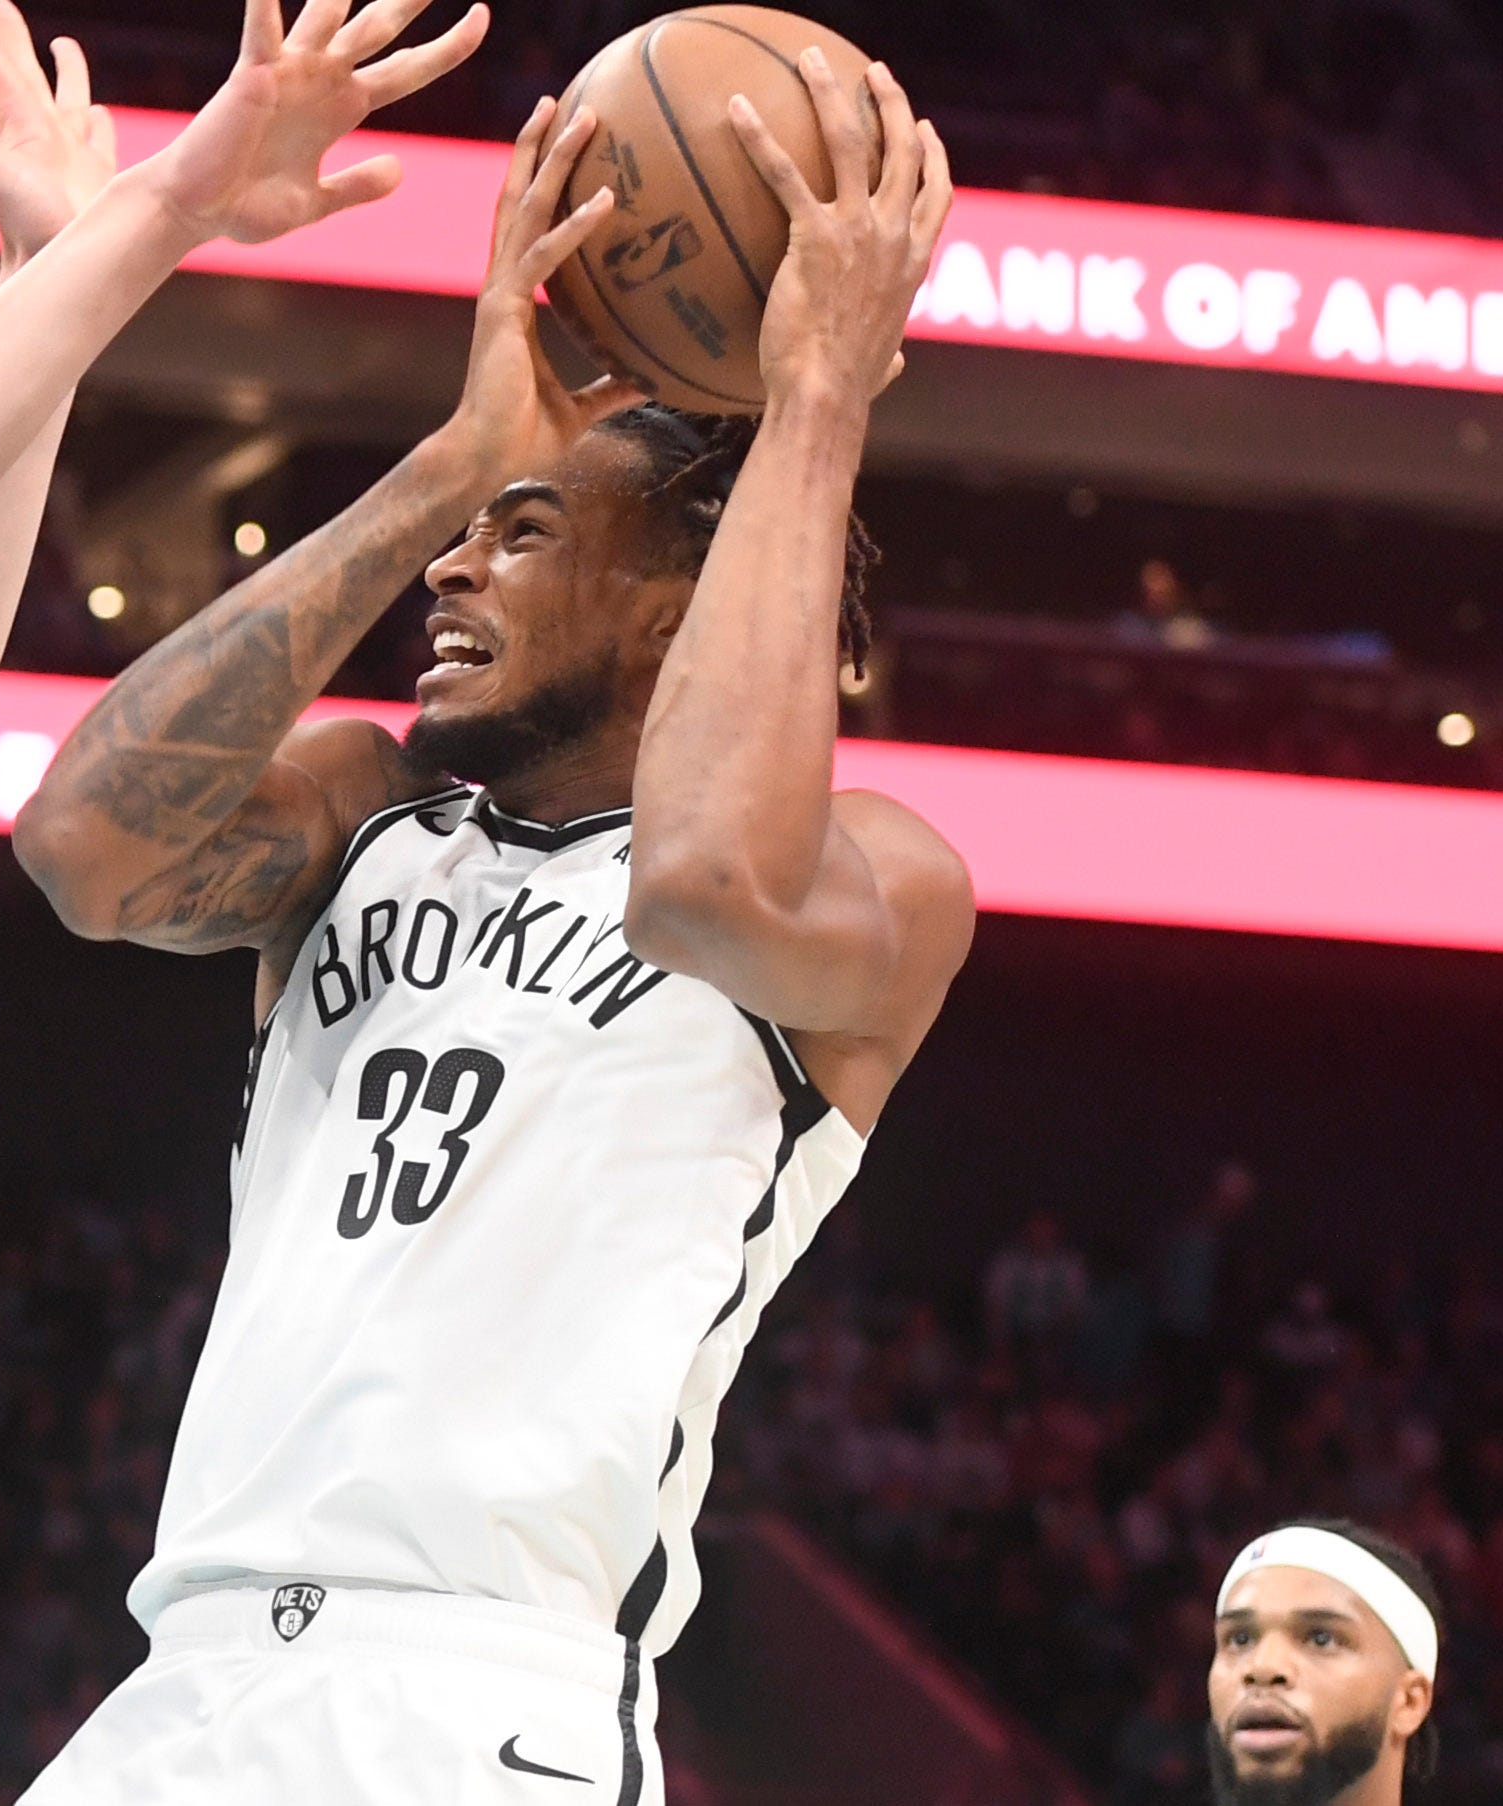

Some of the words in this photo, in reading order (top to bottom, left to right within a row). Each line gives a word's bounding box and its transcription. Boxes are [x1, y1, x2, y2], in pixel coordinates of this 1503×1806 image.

[907, 241, 1148, 342] ANK
[1160, 262, 1302, 355] OF
[337, 1048, 505, 1240] 33
[273, 1586, 323, 1611] NETS
